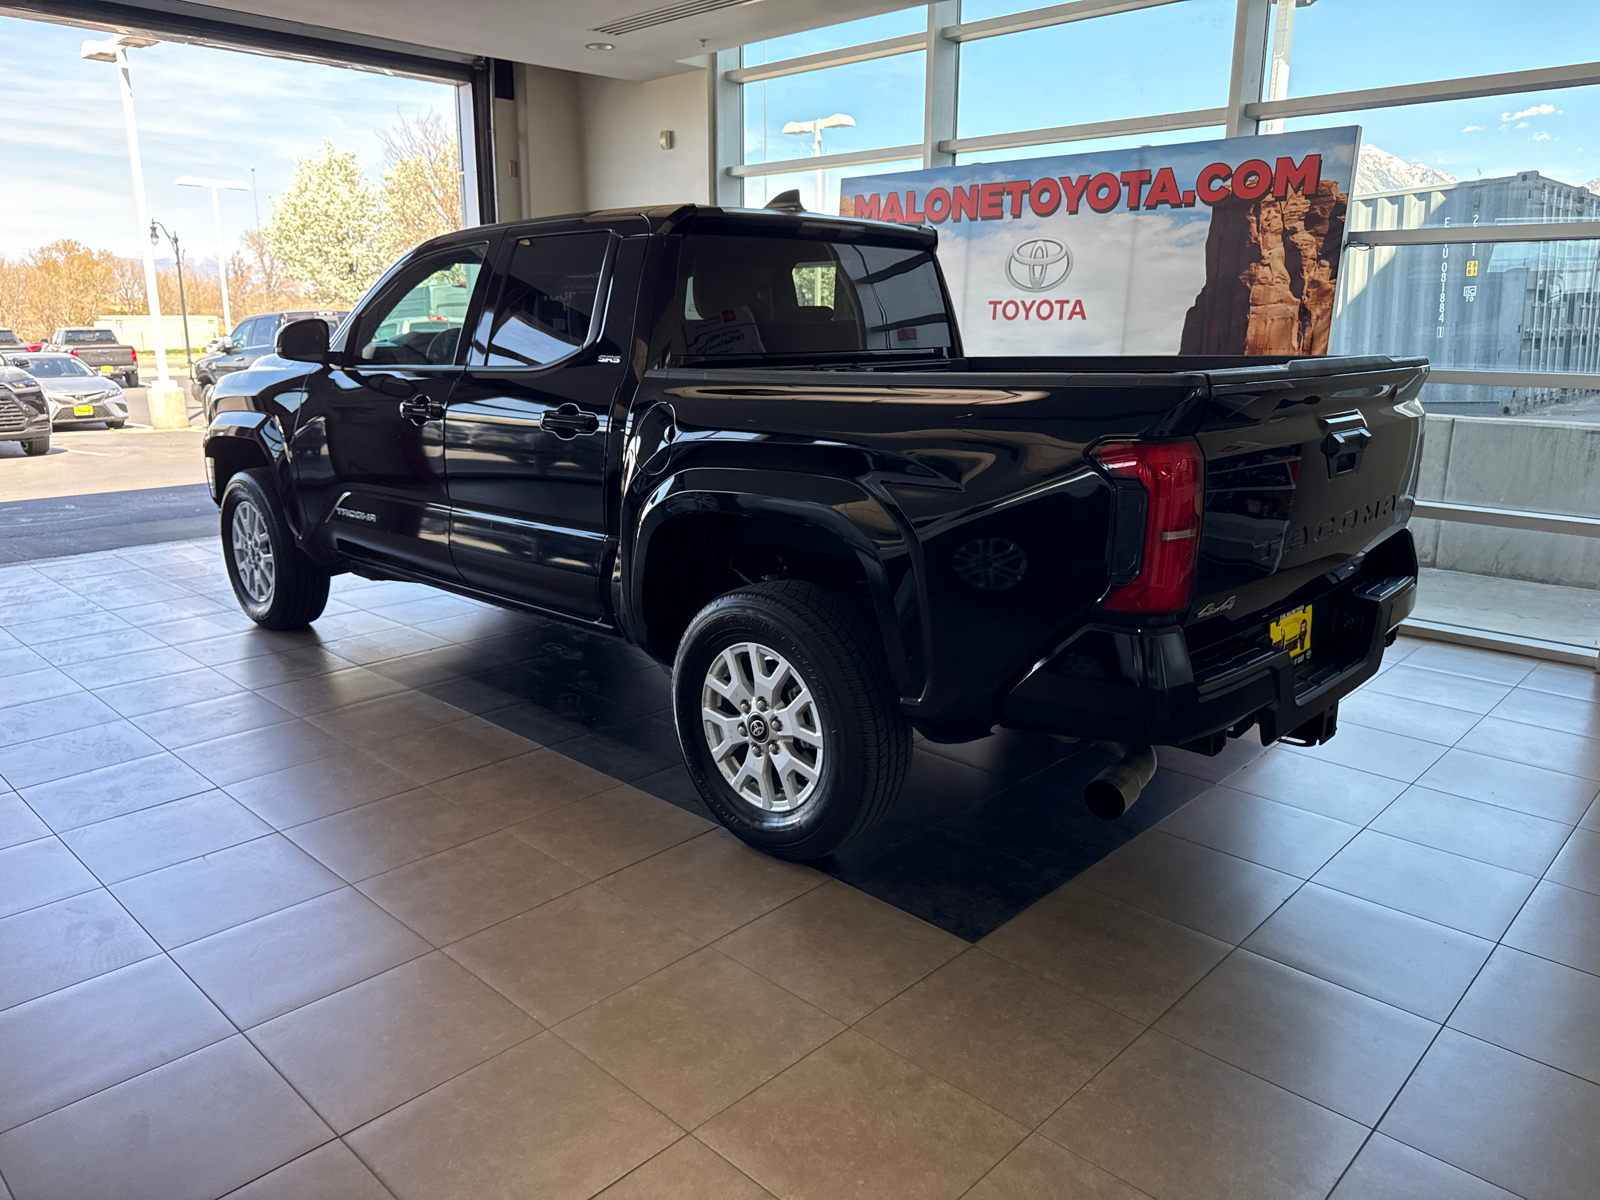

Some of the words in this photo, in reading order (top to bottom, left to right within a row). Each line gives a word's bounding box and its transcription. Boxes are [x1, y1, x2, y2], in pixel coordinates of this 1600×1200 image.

[854, 153, 1322, 224] MALONETOYOTA.COM
[988, 299, 1087, 321] TOYOTA
[1253, 494, 1396, 561] TACOMA
